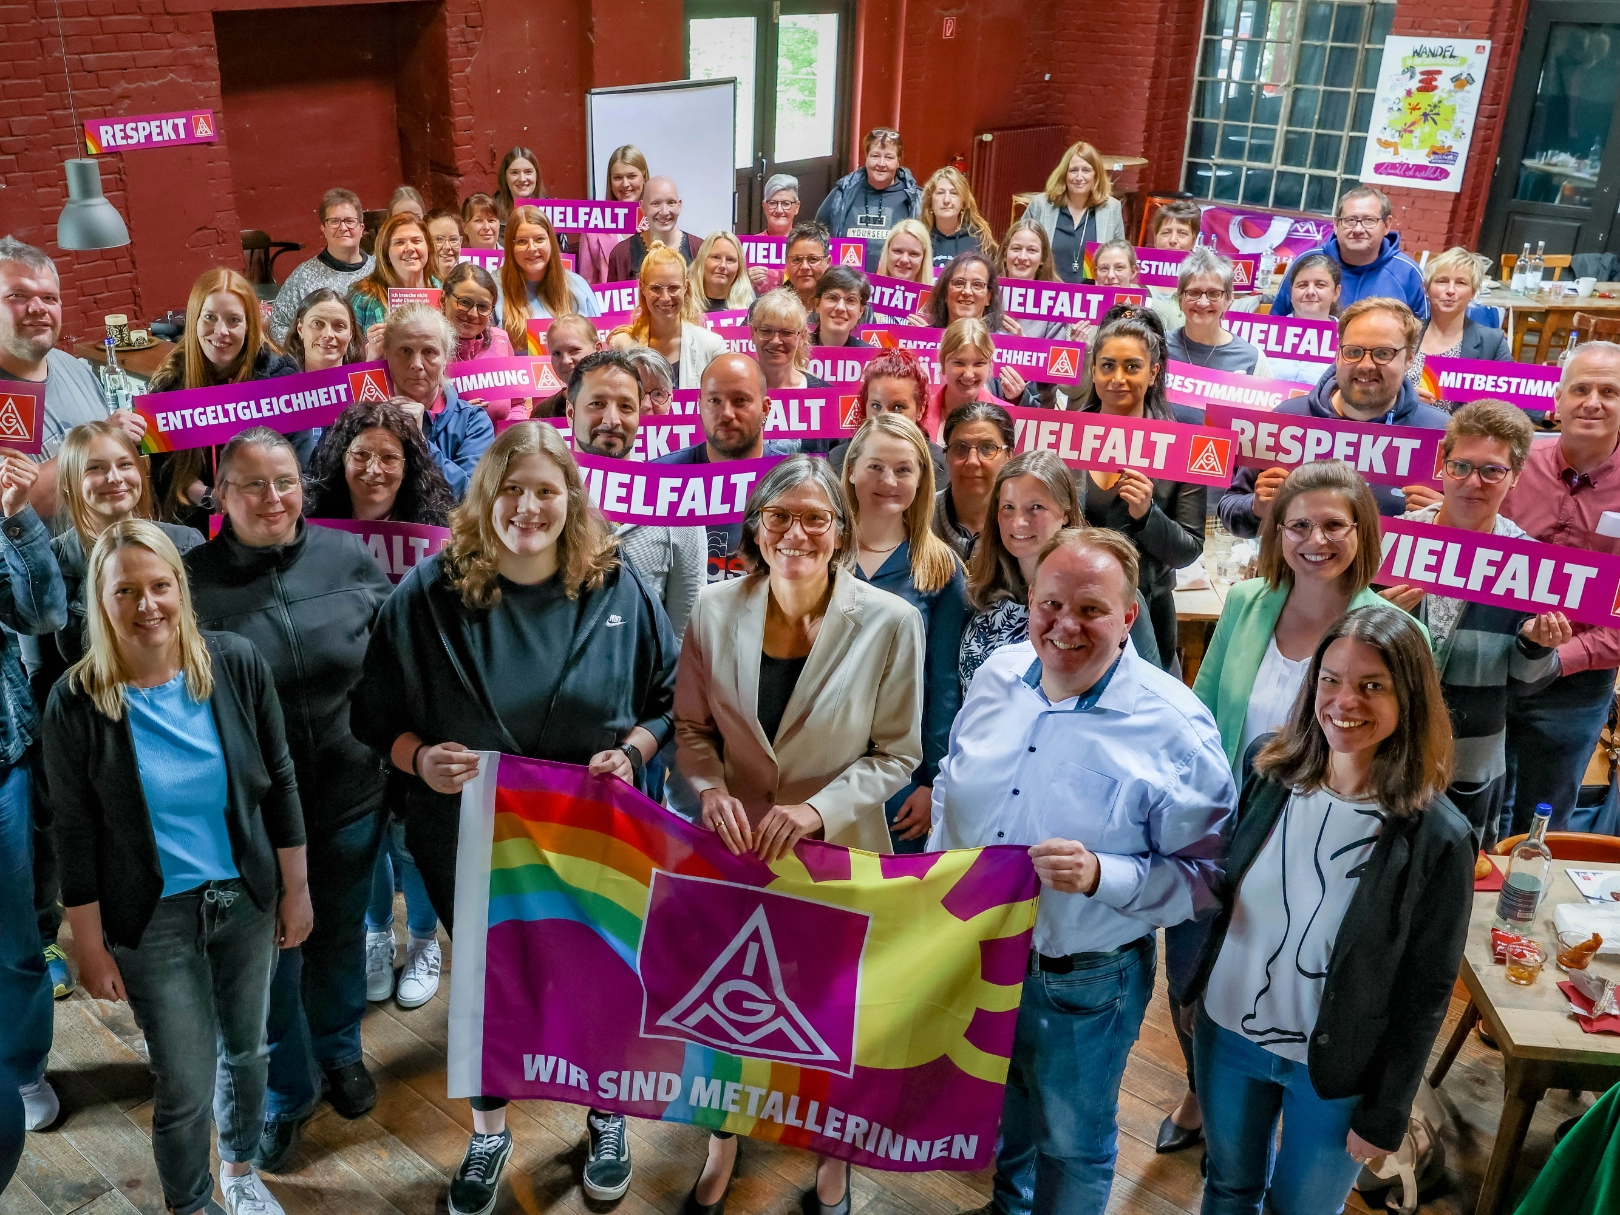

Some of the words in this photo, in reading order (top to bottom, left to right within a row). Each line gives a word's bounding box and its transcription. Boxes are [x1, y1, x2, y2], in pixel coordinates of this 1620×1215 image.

[1412, 44, 1458, 58] WANDEL
[100, 118, 186, 147] RESPEKT
[852, 229, 889, 238] YOURSELF
[1221, 319, 1340, 358] VIELFAL
[156, 384, 347, 432] ENTGELTGLEICHHEIT
[1231, 418, 1421, 476] RESPEKT
[523, 1054, 589, 1091] WIR
[597, 1071, 681, 1102] SIND
[690, 1077, 979, 1161] METALLERINNEN
